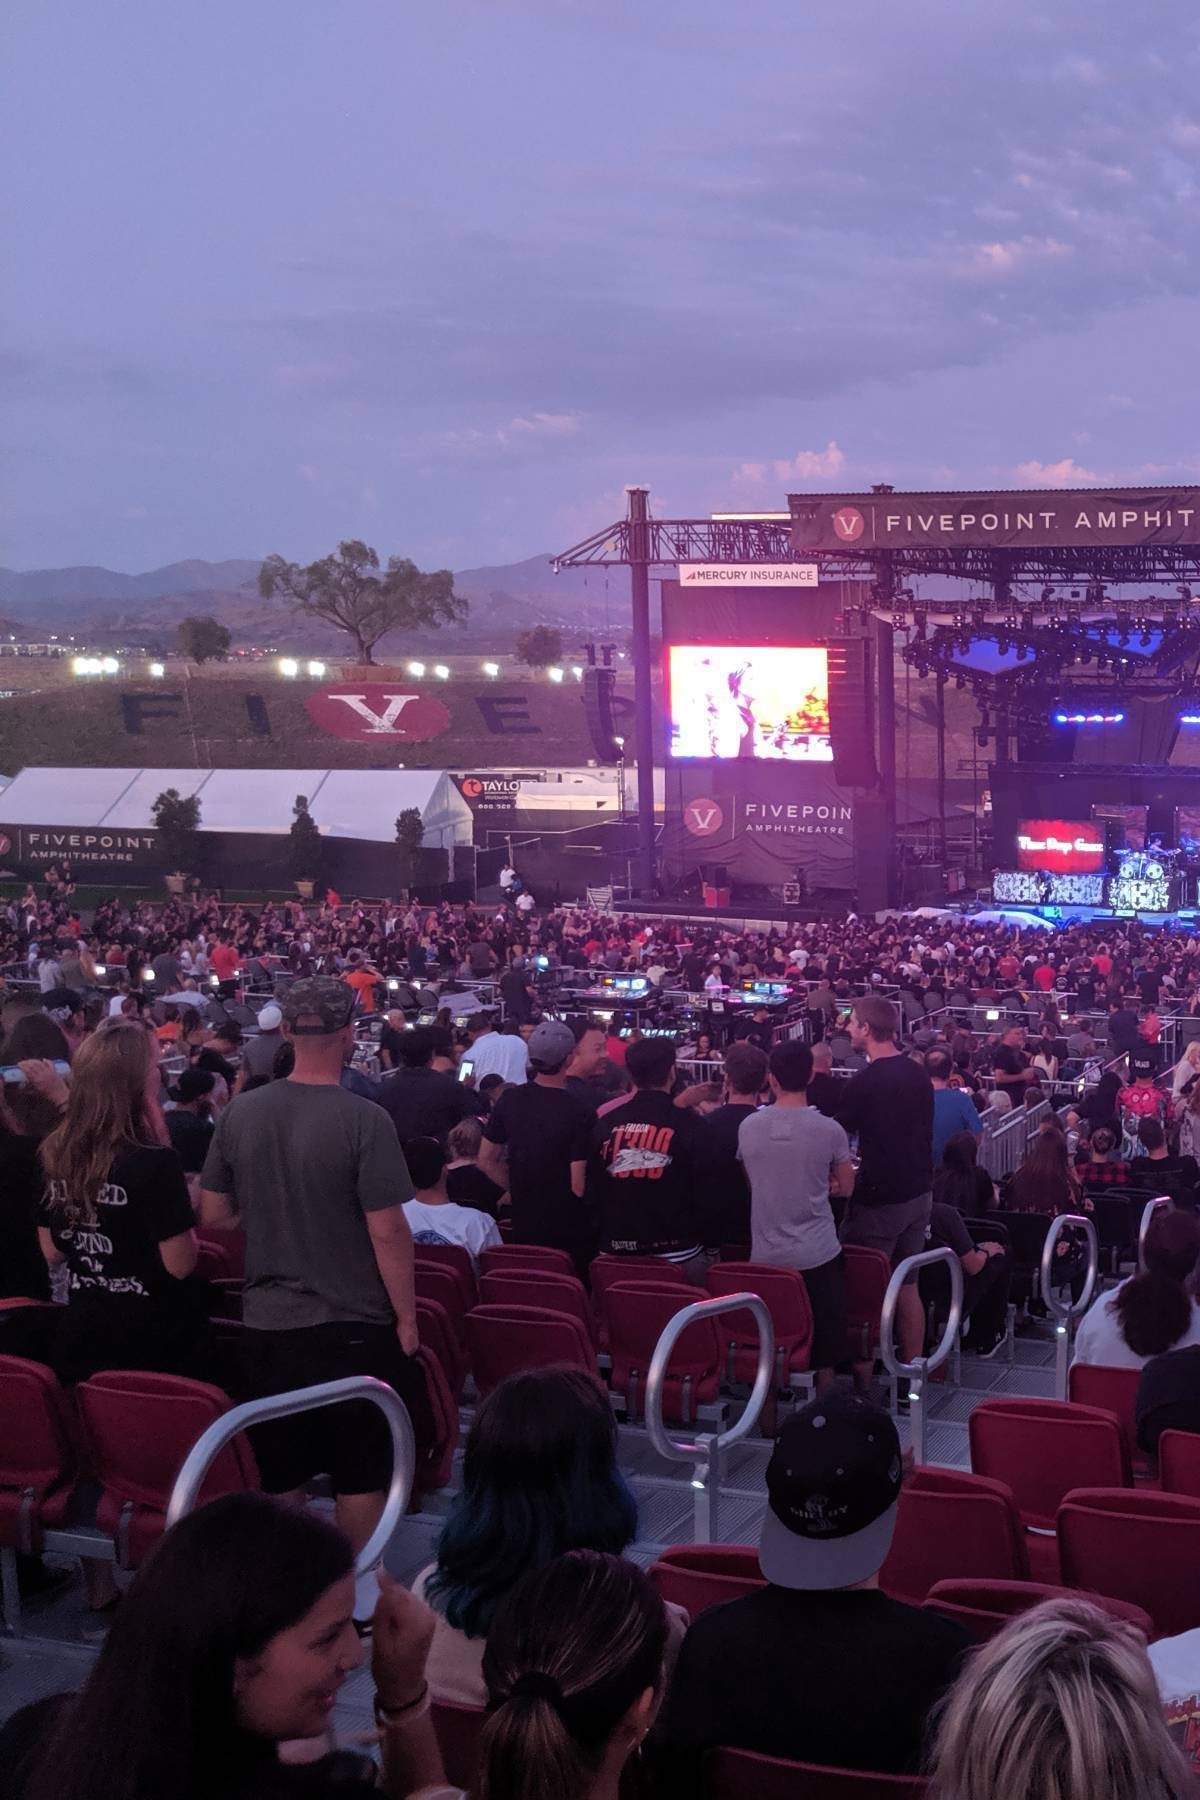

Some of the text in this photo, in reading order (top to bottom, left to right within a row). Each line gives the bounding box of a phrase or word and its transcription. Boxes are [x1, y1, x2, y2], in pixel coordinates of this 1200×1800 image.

[838, 516, 859, 535] V
[886, 512, 1057, 532] FIVEPOINT
[697, 570, 813, 580] MERCURY INSURANCE
[482, 780, 519, 792] TAYLO
[690, 808, 717, 829] V
[745, 804, 852, 820] FIVEPOIN
[745, 823, 845, 835] AMPHITHEATRE
[28, 834, 155, 849] FIVEPOINT
[29, 851, 134, 862] AMPHITHEATRE
